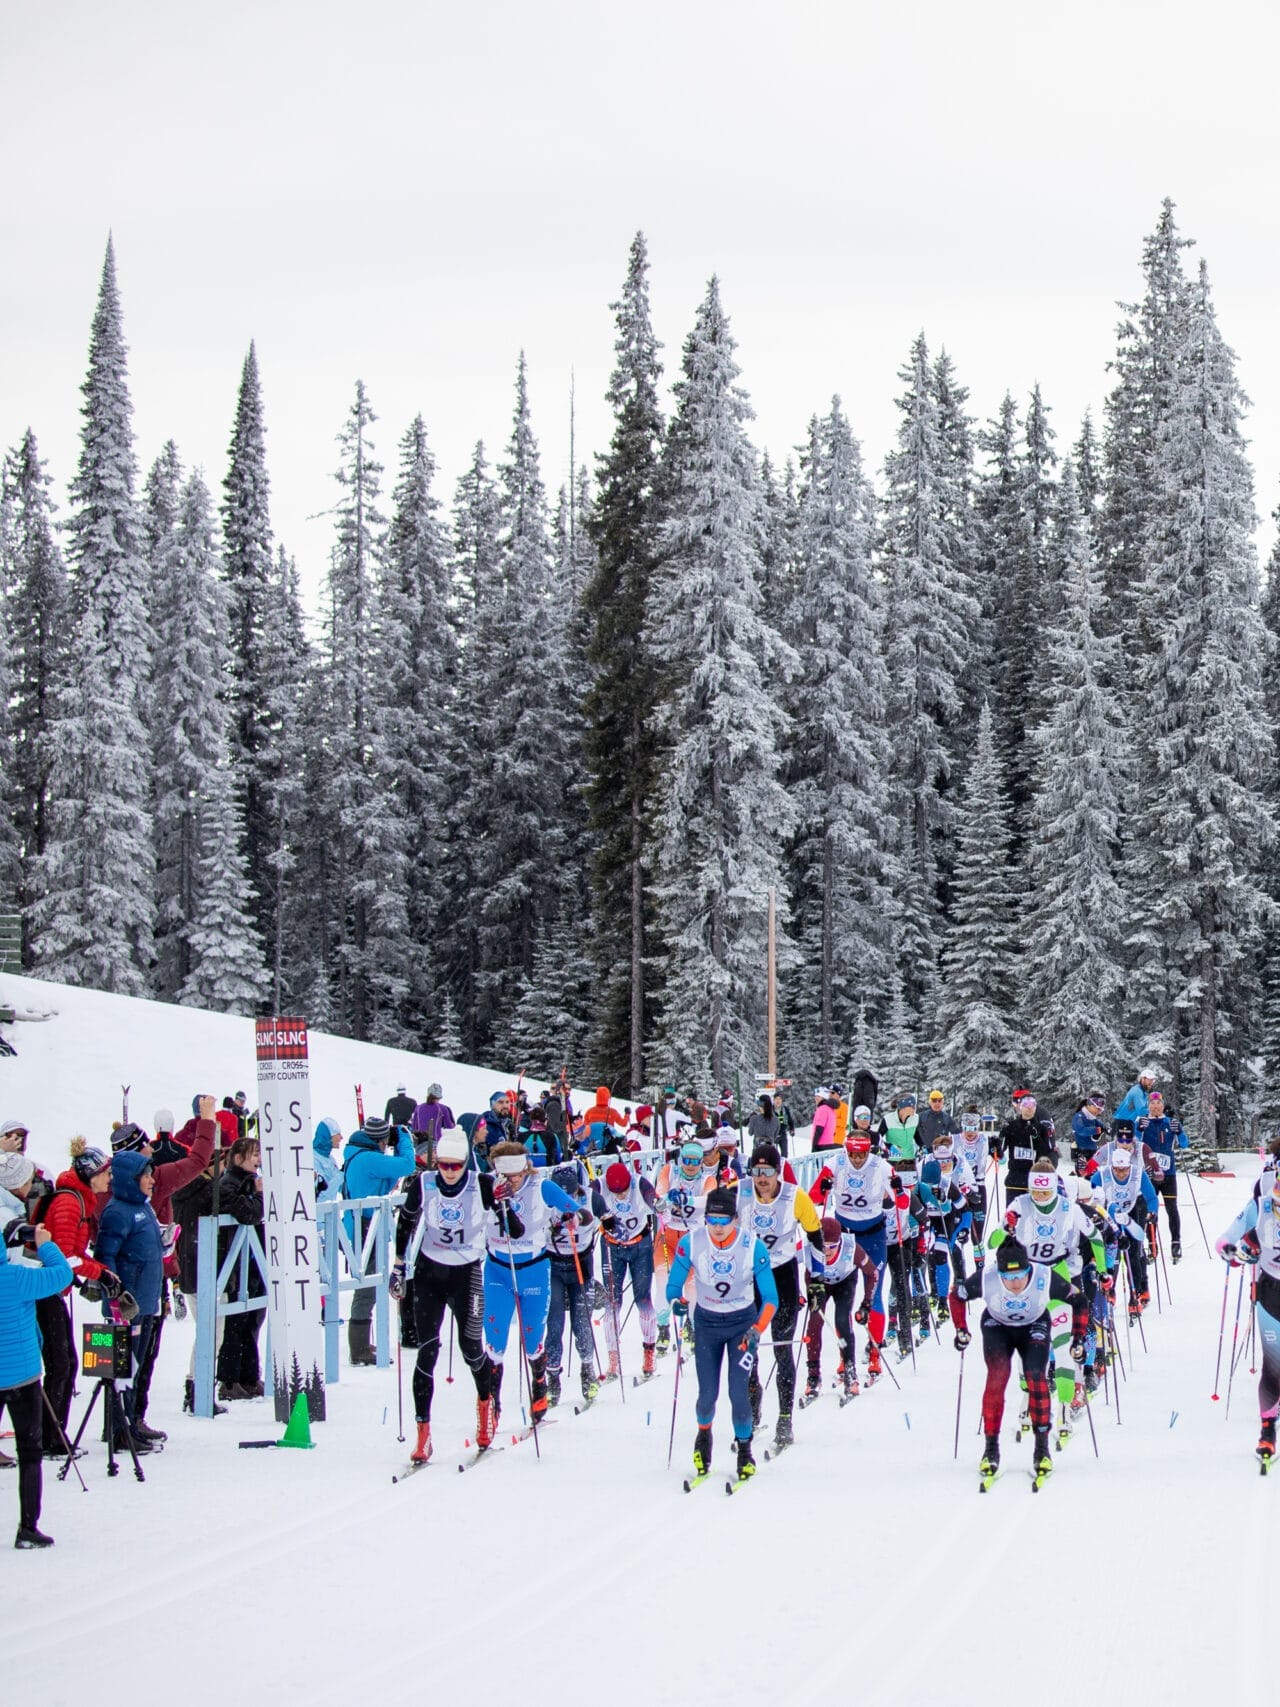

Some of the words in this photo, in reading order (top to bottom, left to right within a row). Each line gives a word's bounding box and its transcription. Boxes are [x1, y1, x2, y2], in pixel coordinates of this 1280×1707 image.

[277, 1031, 306, 1046] SLNC
[281, 1061, 304, 1070] CROSS
[277, 1072, 308, 1080] COUNTRY
[1034, 1177, 1049, 1186] ed
[264, 1102, 280, 1311] START
[289, 1101, 310, 1310] START
[841, 1193, 868, 1208] 26
[439, 1227, 465, 1244] 31
[1030, 1244, 1055, 1258] 18
[715, 1282, 730, 1297] 9
